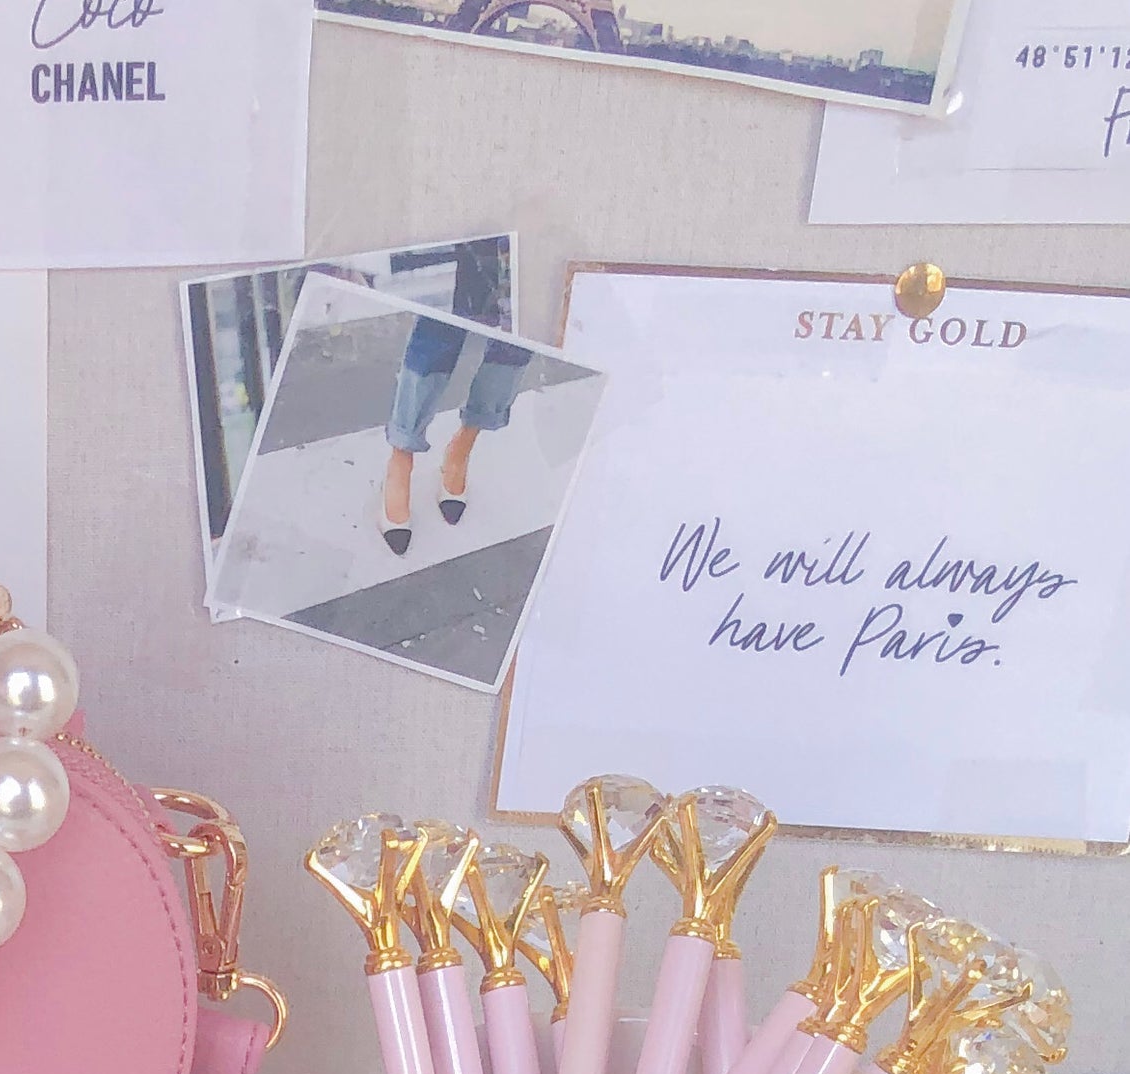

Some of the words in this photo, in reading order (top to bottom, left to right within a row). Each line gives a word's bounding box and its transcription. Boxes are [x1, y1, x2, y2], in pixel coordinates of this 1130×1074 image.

[31, 0, 165, 49] Coco
[31, 61, 166, 104] CHANEL
[794, 310, 894, 342] STAY
[908, 317, 1028, 349] GOLD
[659, 517, 740, 591] We
[763, 531, 871, 587] will
[884, 536, 1079, 623] always
[709, 593, 825, 653] have
[840, 602, 1003, 677] Paris.
